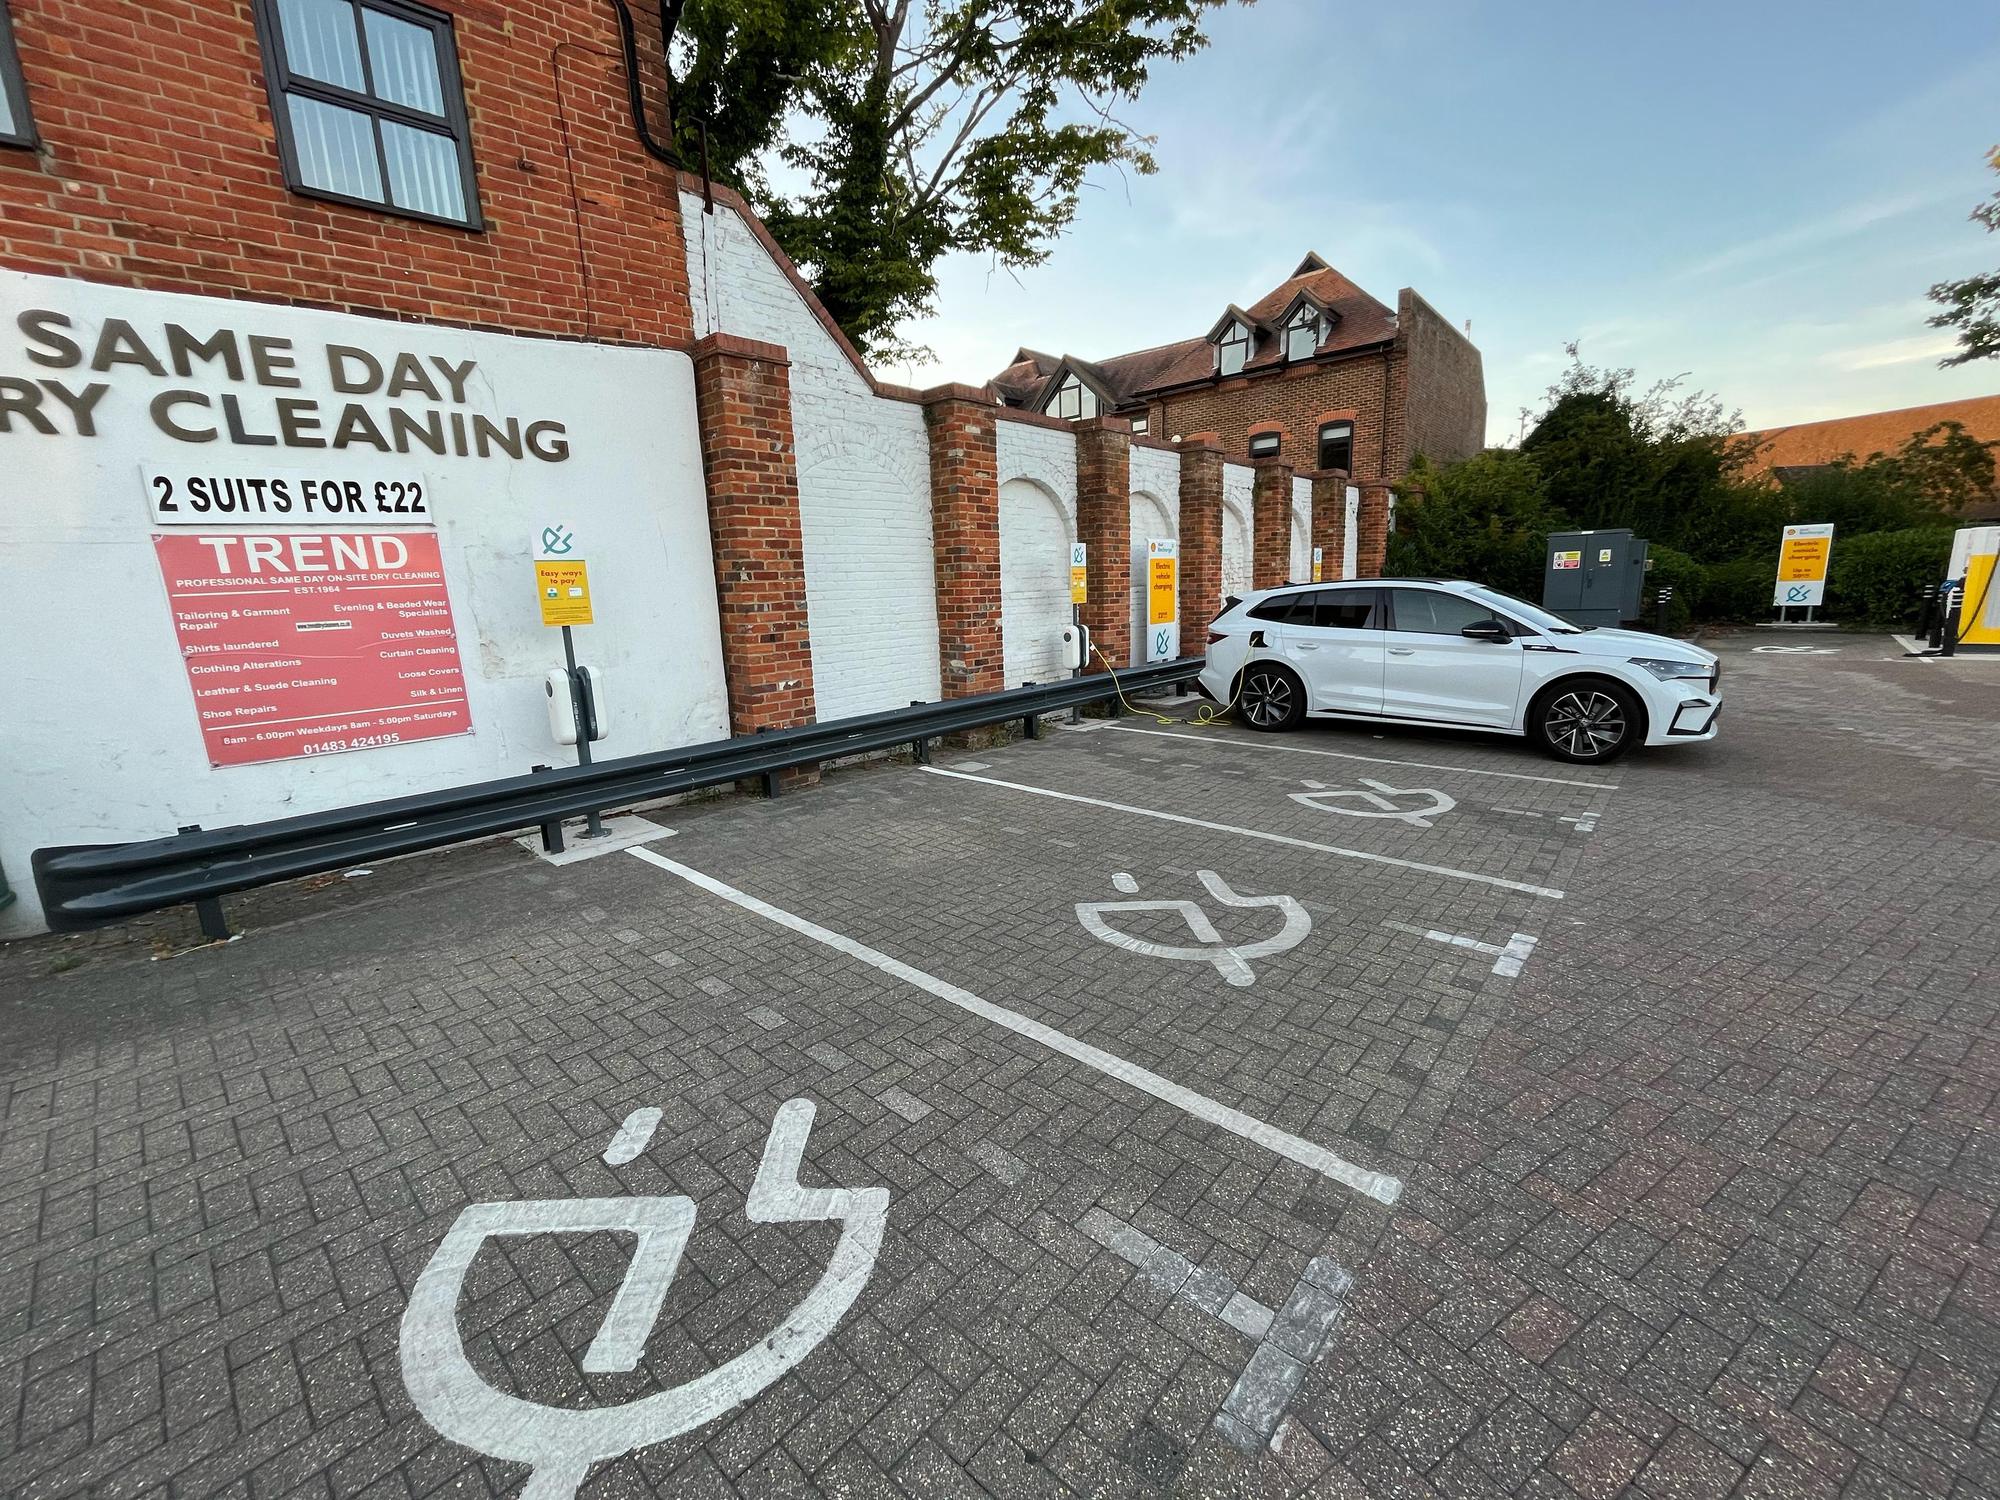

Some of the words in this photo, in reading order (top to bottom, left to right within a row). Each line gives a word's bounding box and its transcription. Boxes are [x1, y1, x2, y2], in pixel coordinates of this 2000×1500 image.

[17, 309, 301, 387] SAME
[325, 343, 478, 404] DAY
[0, 376, 110, 436] RY
[150, 389, 570, 462] CLEANING
[153, 476, 178, 512] 2
[187, 477, 292, 513] SUITS
[300, 480, 367, 513] FOR
[374, 481, 426, 513] £22
[199, 536, 408, 574] TREND
[176, 577, 268, 588] PROFESSIONAL
[269, 575, 301, 585] SAME
[303, 574, 325, 583] DAY
[327, 573, 367, 583] ON-SITE
[370, 573, 389, 581] DRY
[392, 571, 441, 579] CLEANING
[540, 569, 559, 578] Easy
[561, 570, 583, 578] ways
[560, 578, 576, 586] pay
[294, 586, 340, 595] EST.1964
[334, 603, 375, 613] Evening
[376, 602, 385, 610] &
[386, 600, 421, 609] Beaded
[423, 599, 446, 607] Wear
[176, 611, 229, 621] Tailoring
[231, 609, 240, 618] &
[242, 607, 290, 618] Garment
[398, 608, 448, 619] Specialists
[180, 621, 219, 632] Repair
[381, 631, 414, 640] Duvets
[415, 628, 452, 637] Washed
[185, 644, 221, 655] Shirts
[223, 640, 280, 651] laundered
[379, 650, 414, 659] Curtain
[416, 646, 455, 656] Cleaning
[190, 664, 241, 675] Clothing
[242, 658, 302, 670] Alterations
[398, 670, 427, 679] Loose
[428, 667, 460, 676] Covers
[196, 686, 240, 697] Leather
[243, 684, 252, 693] &
[254, 681, 289, 692] Suede
[291, 677, 337, 688] Cleaning
[410, 689, 428, 698] Silk
[429, 688, 437, 696] &
[438, 685, 463, 695] Linen
[202, 709, 233, 720] Shoe
[235, 704, 278, 717] Repairs
[256, 730, 295, 741] 6.00pm
[296, 723, 348, 735] Weekdays
[378, 715, 412, 726] 5.00pm
[413, 709, 458, 721] Saturdays
[303, 739, 347, 755] 01483
[350, 732, 400, 748] 424195
